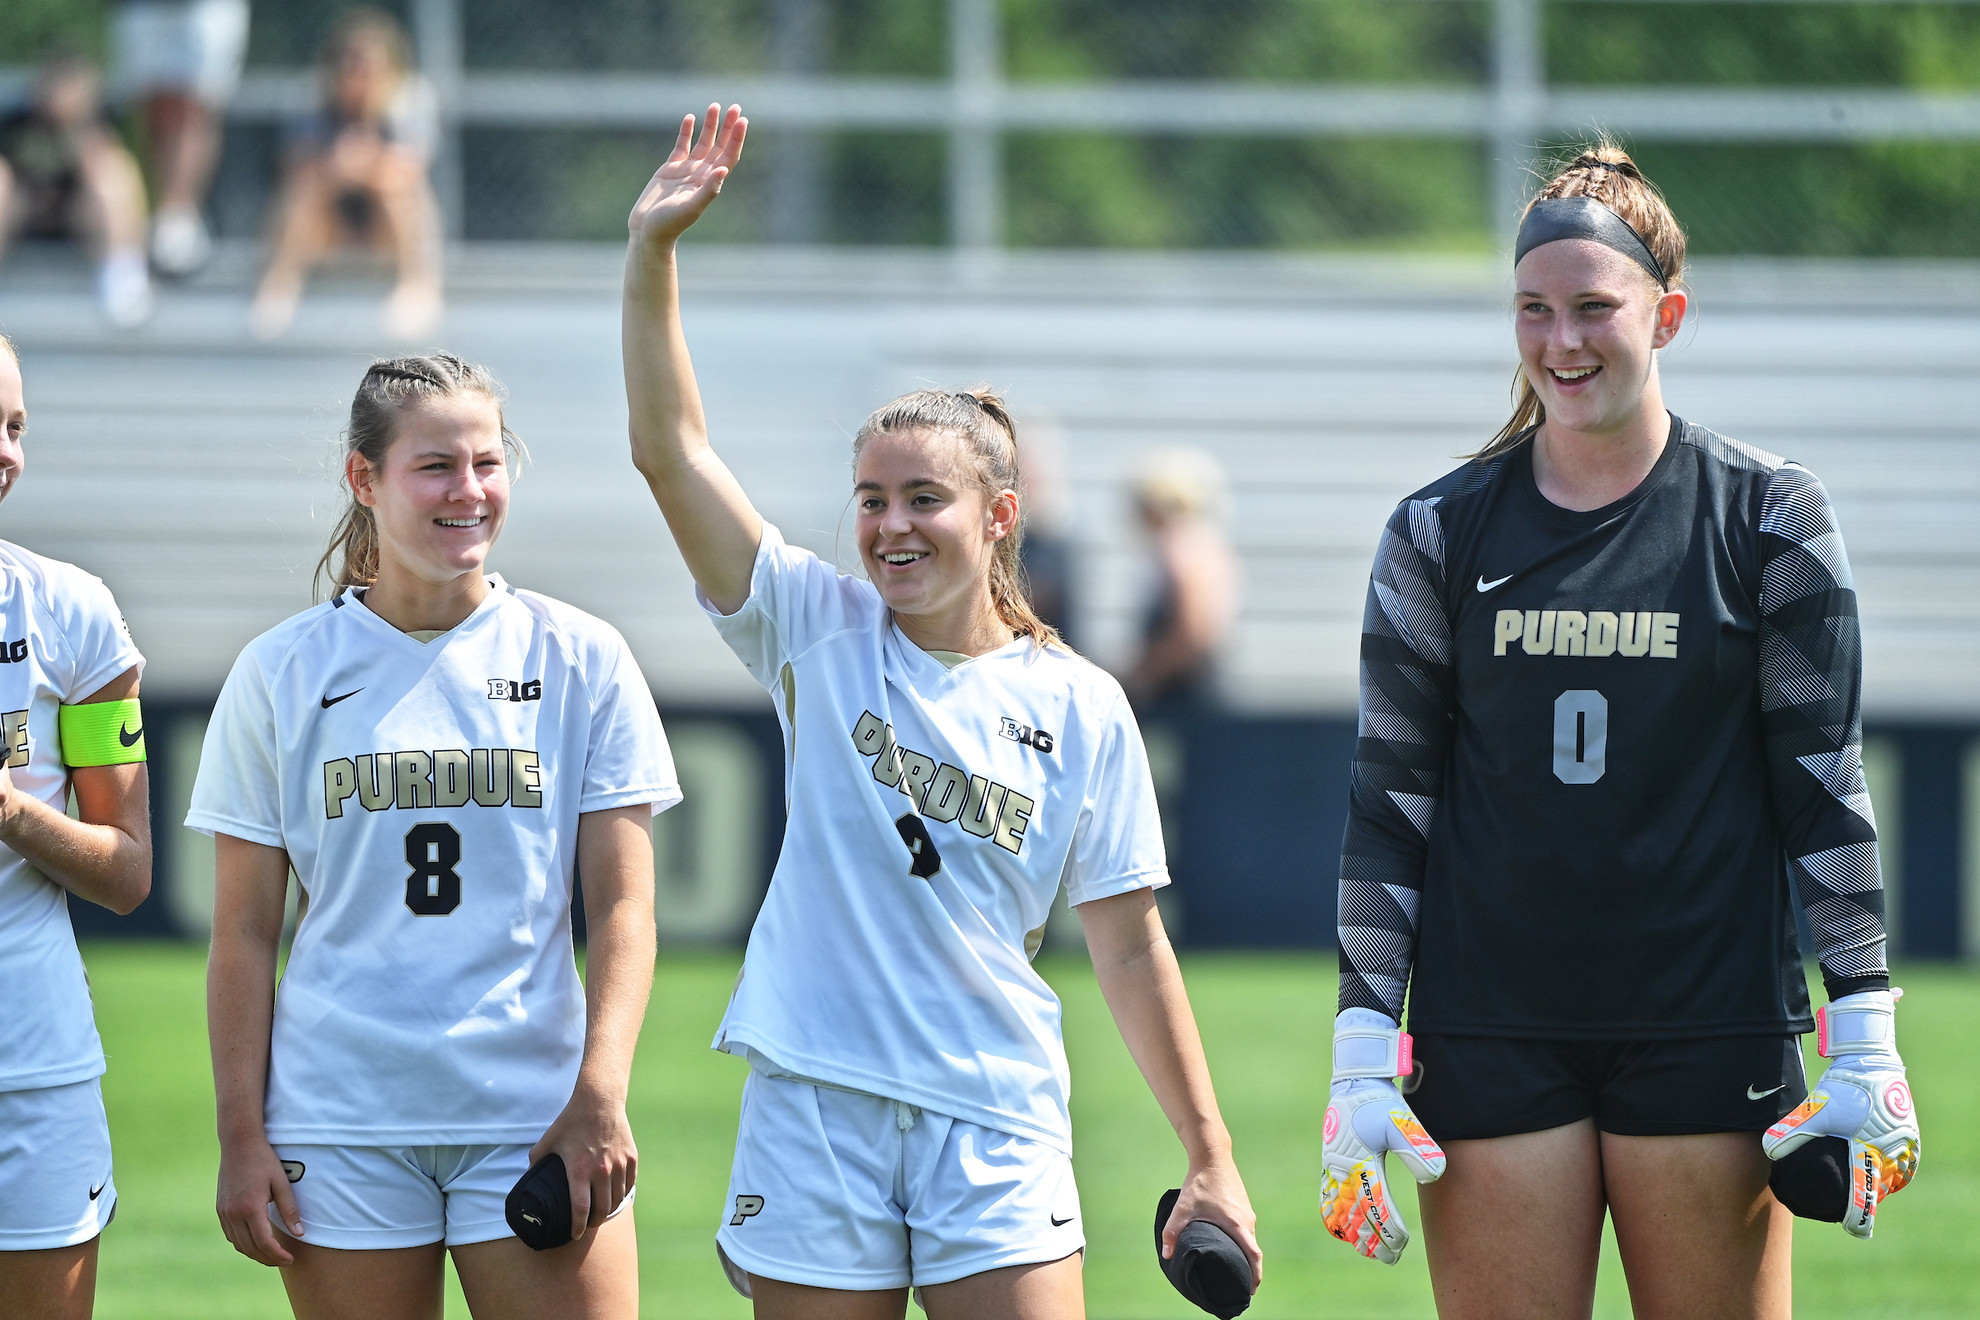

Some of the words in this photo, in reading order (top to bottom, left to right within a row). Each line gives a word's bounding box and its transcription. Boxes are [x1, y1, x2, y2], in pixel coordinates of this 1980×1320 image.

[1494, 610, 1680, 658] PURDUE
[1553, 689, 1608, 785] 0
[324, 749, 542, 819] PURDUE
[404, 821, 462, 917] 8
[1864, 1151, 1873, 1192] COAST
[729, 1194, 765, 1226] P
[1360, 1171, 1374, 1203] WEST
[1370, 1205, 1394, 1240] COAST
[1858, 1192, 1872, 1226] WEST
